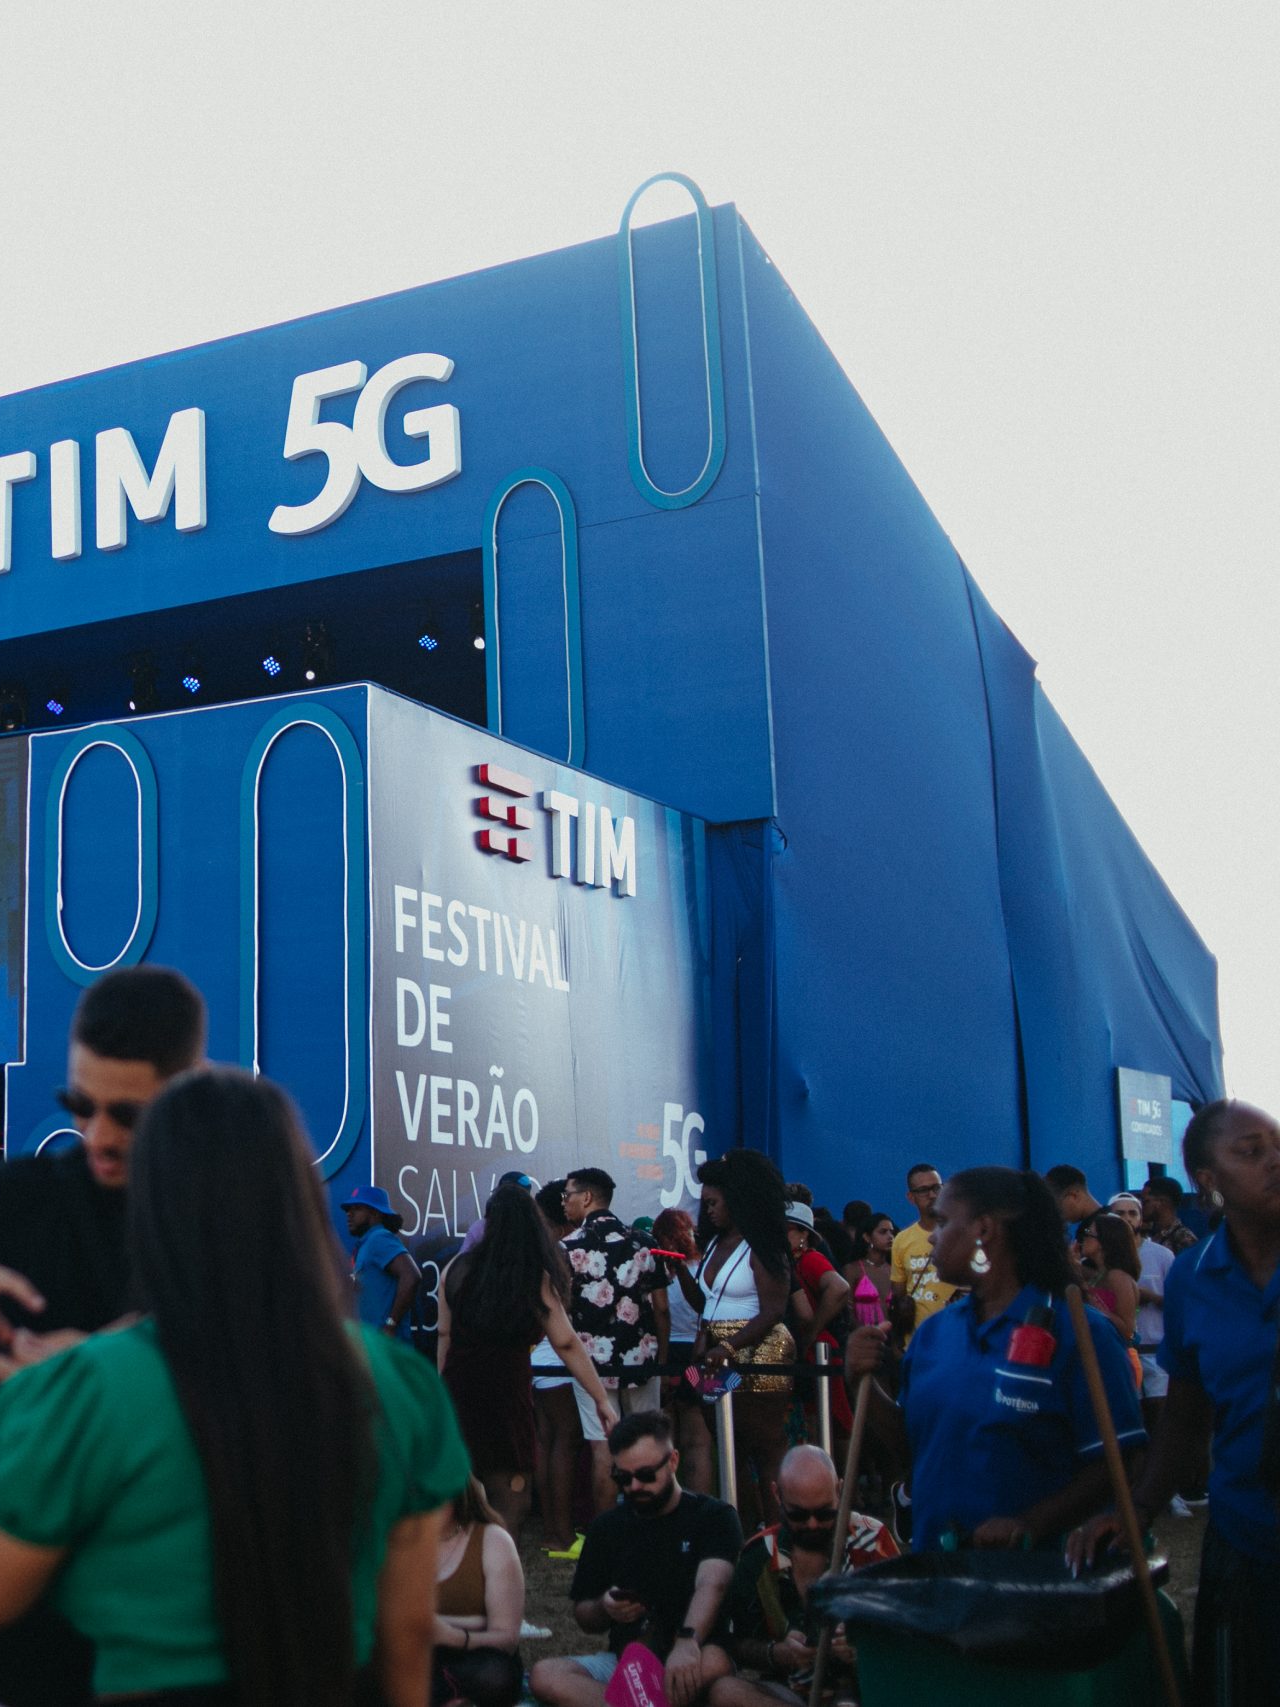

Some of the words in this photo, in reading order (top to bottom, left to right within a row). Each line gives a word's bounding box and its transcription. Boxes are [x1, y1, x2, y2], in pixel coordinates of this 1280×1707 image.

[268, 352, 462, 536] 5G
[542, 790, 636, 899] TIM
[394, 884, 570, 993] FESTIVAL
[396, 976, 454, 1054] DE
[395, 1065, 540, 1154] VERÃO
[660, 1102, 707, 1208] 5G
